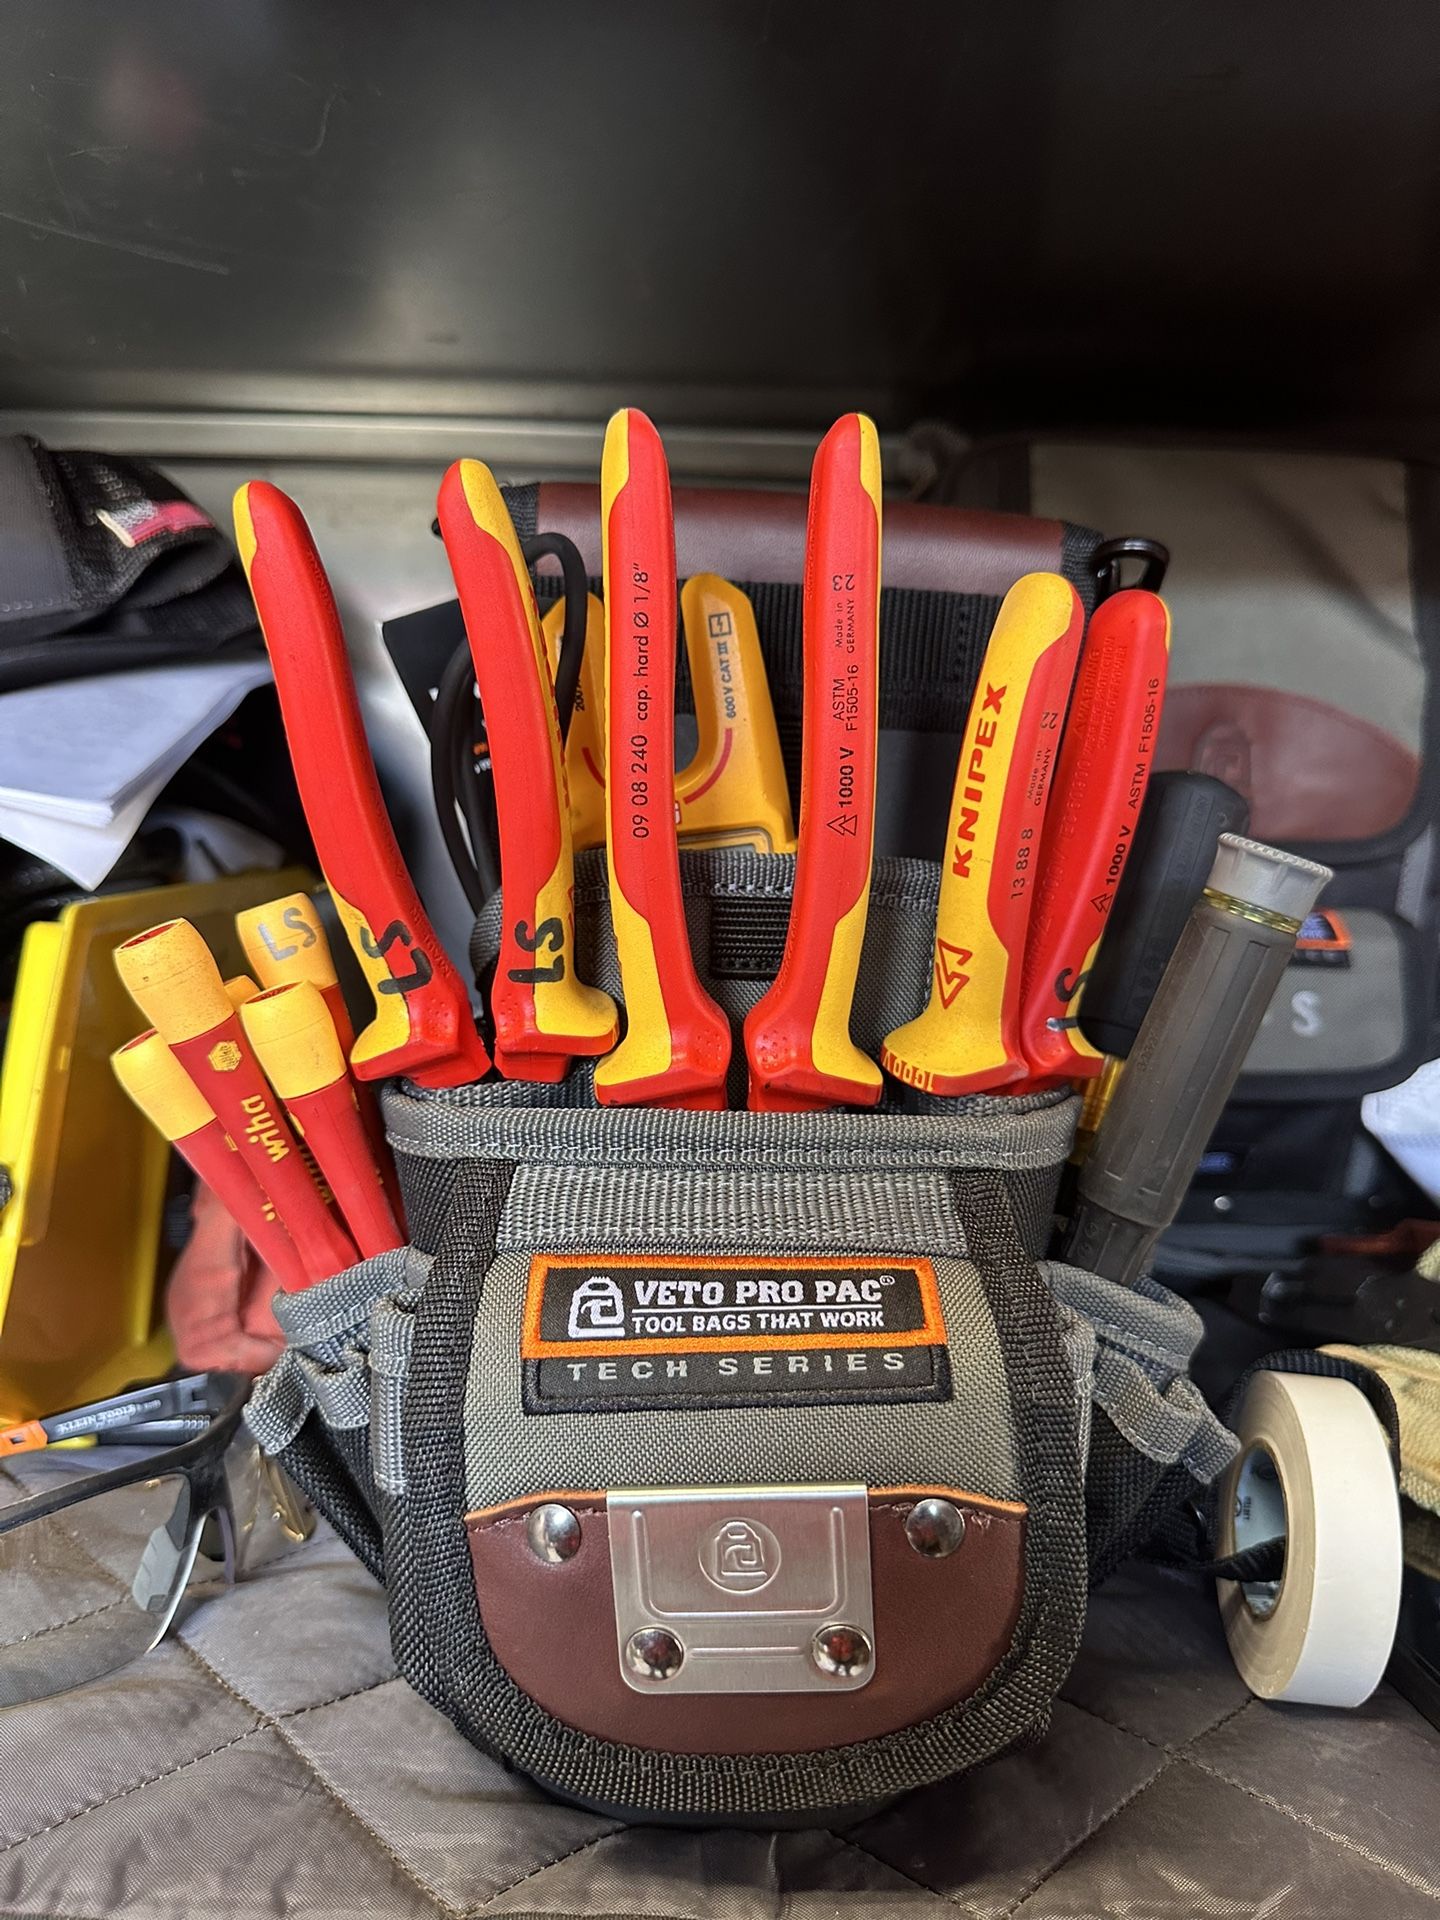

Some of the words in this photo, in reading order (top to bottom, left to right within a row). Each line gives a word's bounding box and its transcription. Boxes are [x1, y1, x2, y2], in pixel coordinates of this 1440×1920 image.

[835, 602, 843, 612] in
[835, 618, 843, 648] Made
[846, 598, 855, 654] GERMANY
[633, 635, 650, 678] hard
[718, 658, 732, 683] CAT
[636, 683, 653, 721] cap.
[833, 678, 845, 721] ASTM
[846, 664, 859, 731] F1505-16
[631, 734, 649, 775] 240
[839, 747, 854, 760] V
[631, 781, 649, 807] 08
[839, 765, 854, 808] 1000
[951, 683, 1009, 879] KNIPEX
[1027, 767, 1038, 799] Made
[1033, 747, 1052, 807] GERMANY
[1106, 843, 1127, 886] 1000
[1118, 825, 1131, 838] V
[1127, 763, 1147, 810] ASTM
[1138, 678, 1160, 753] F1505-16
[632, 813, 650, 839] 09
[1021, 828, 1034, 840] 8
[1016, 847, 1031, 870] 88
[1011, 877, 1026, 899] 13
[257, 907, 318, 961] LS
[507, 916, 565, 985] LS
[360, 919, 434, 995] LS
[634, 1280, 724, 1305] VETO
[735, 1279, 804, 1304] PRO
[631, 1316, 687, 1334] TOOL
[692, 1313, 751, 1332] BAGS
[756, 1311, 813, 1329] THAT
[819, 1310, 885, 1328] WORK
[567, 1358, 688, 1382] TECH
[718, 1352, 906, 1377] SERIES
